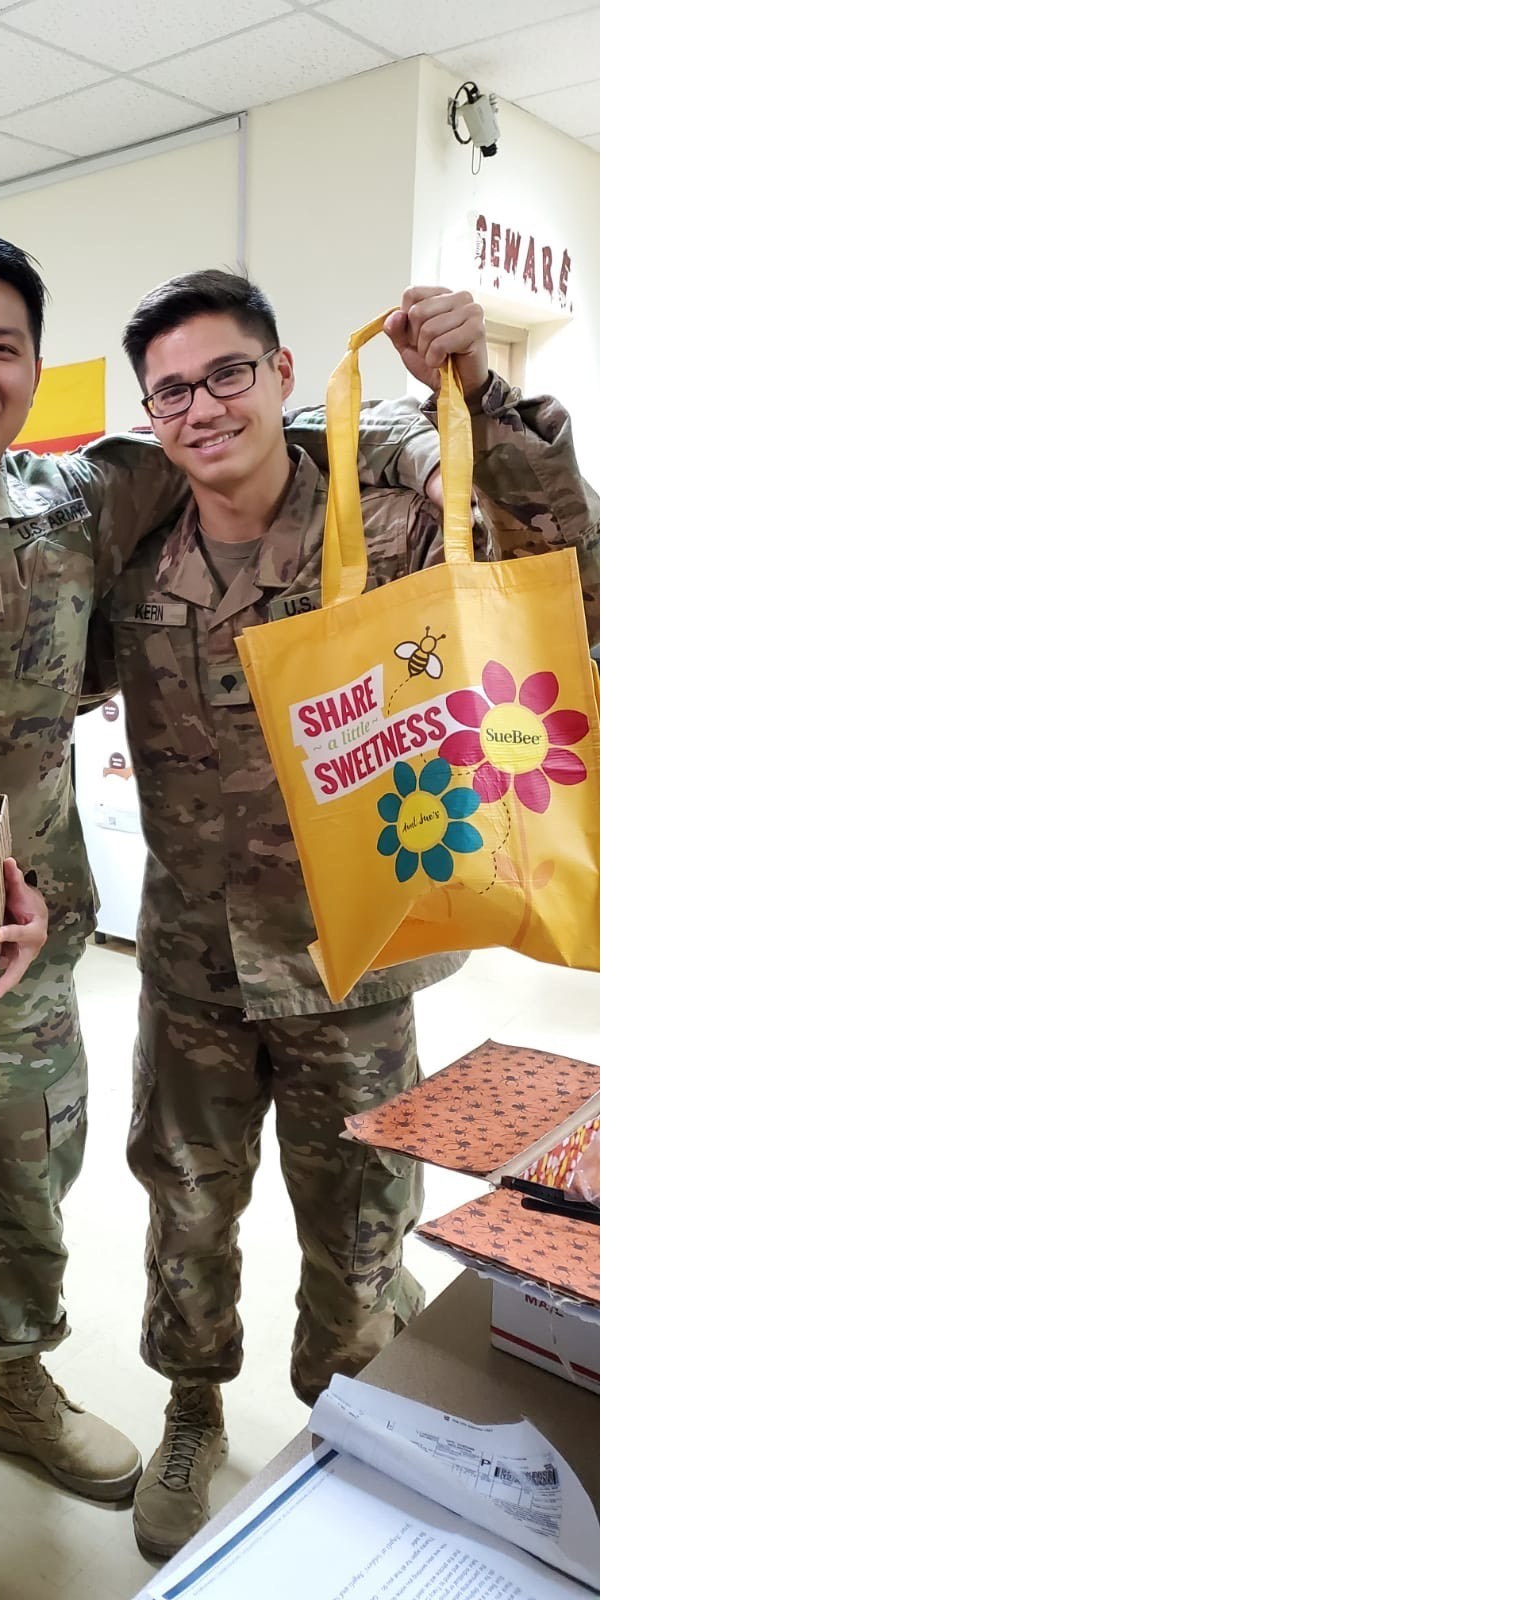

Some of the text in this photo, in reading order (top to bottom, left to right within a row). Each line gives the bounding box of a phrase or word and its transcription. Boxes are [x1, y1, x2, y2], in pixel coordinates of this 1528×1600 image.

[48, 501, 86, 528] ARMY
[134, 603, 164, 622] KERN
[285, 597, 316, 617] U.S.
[298, 676, 378, 737] SHARE
[342, 721, 371, 746] little
[486, 728, 541, 745] SueBee
[314, 706, 447, 795] SWEETNESS
